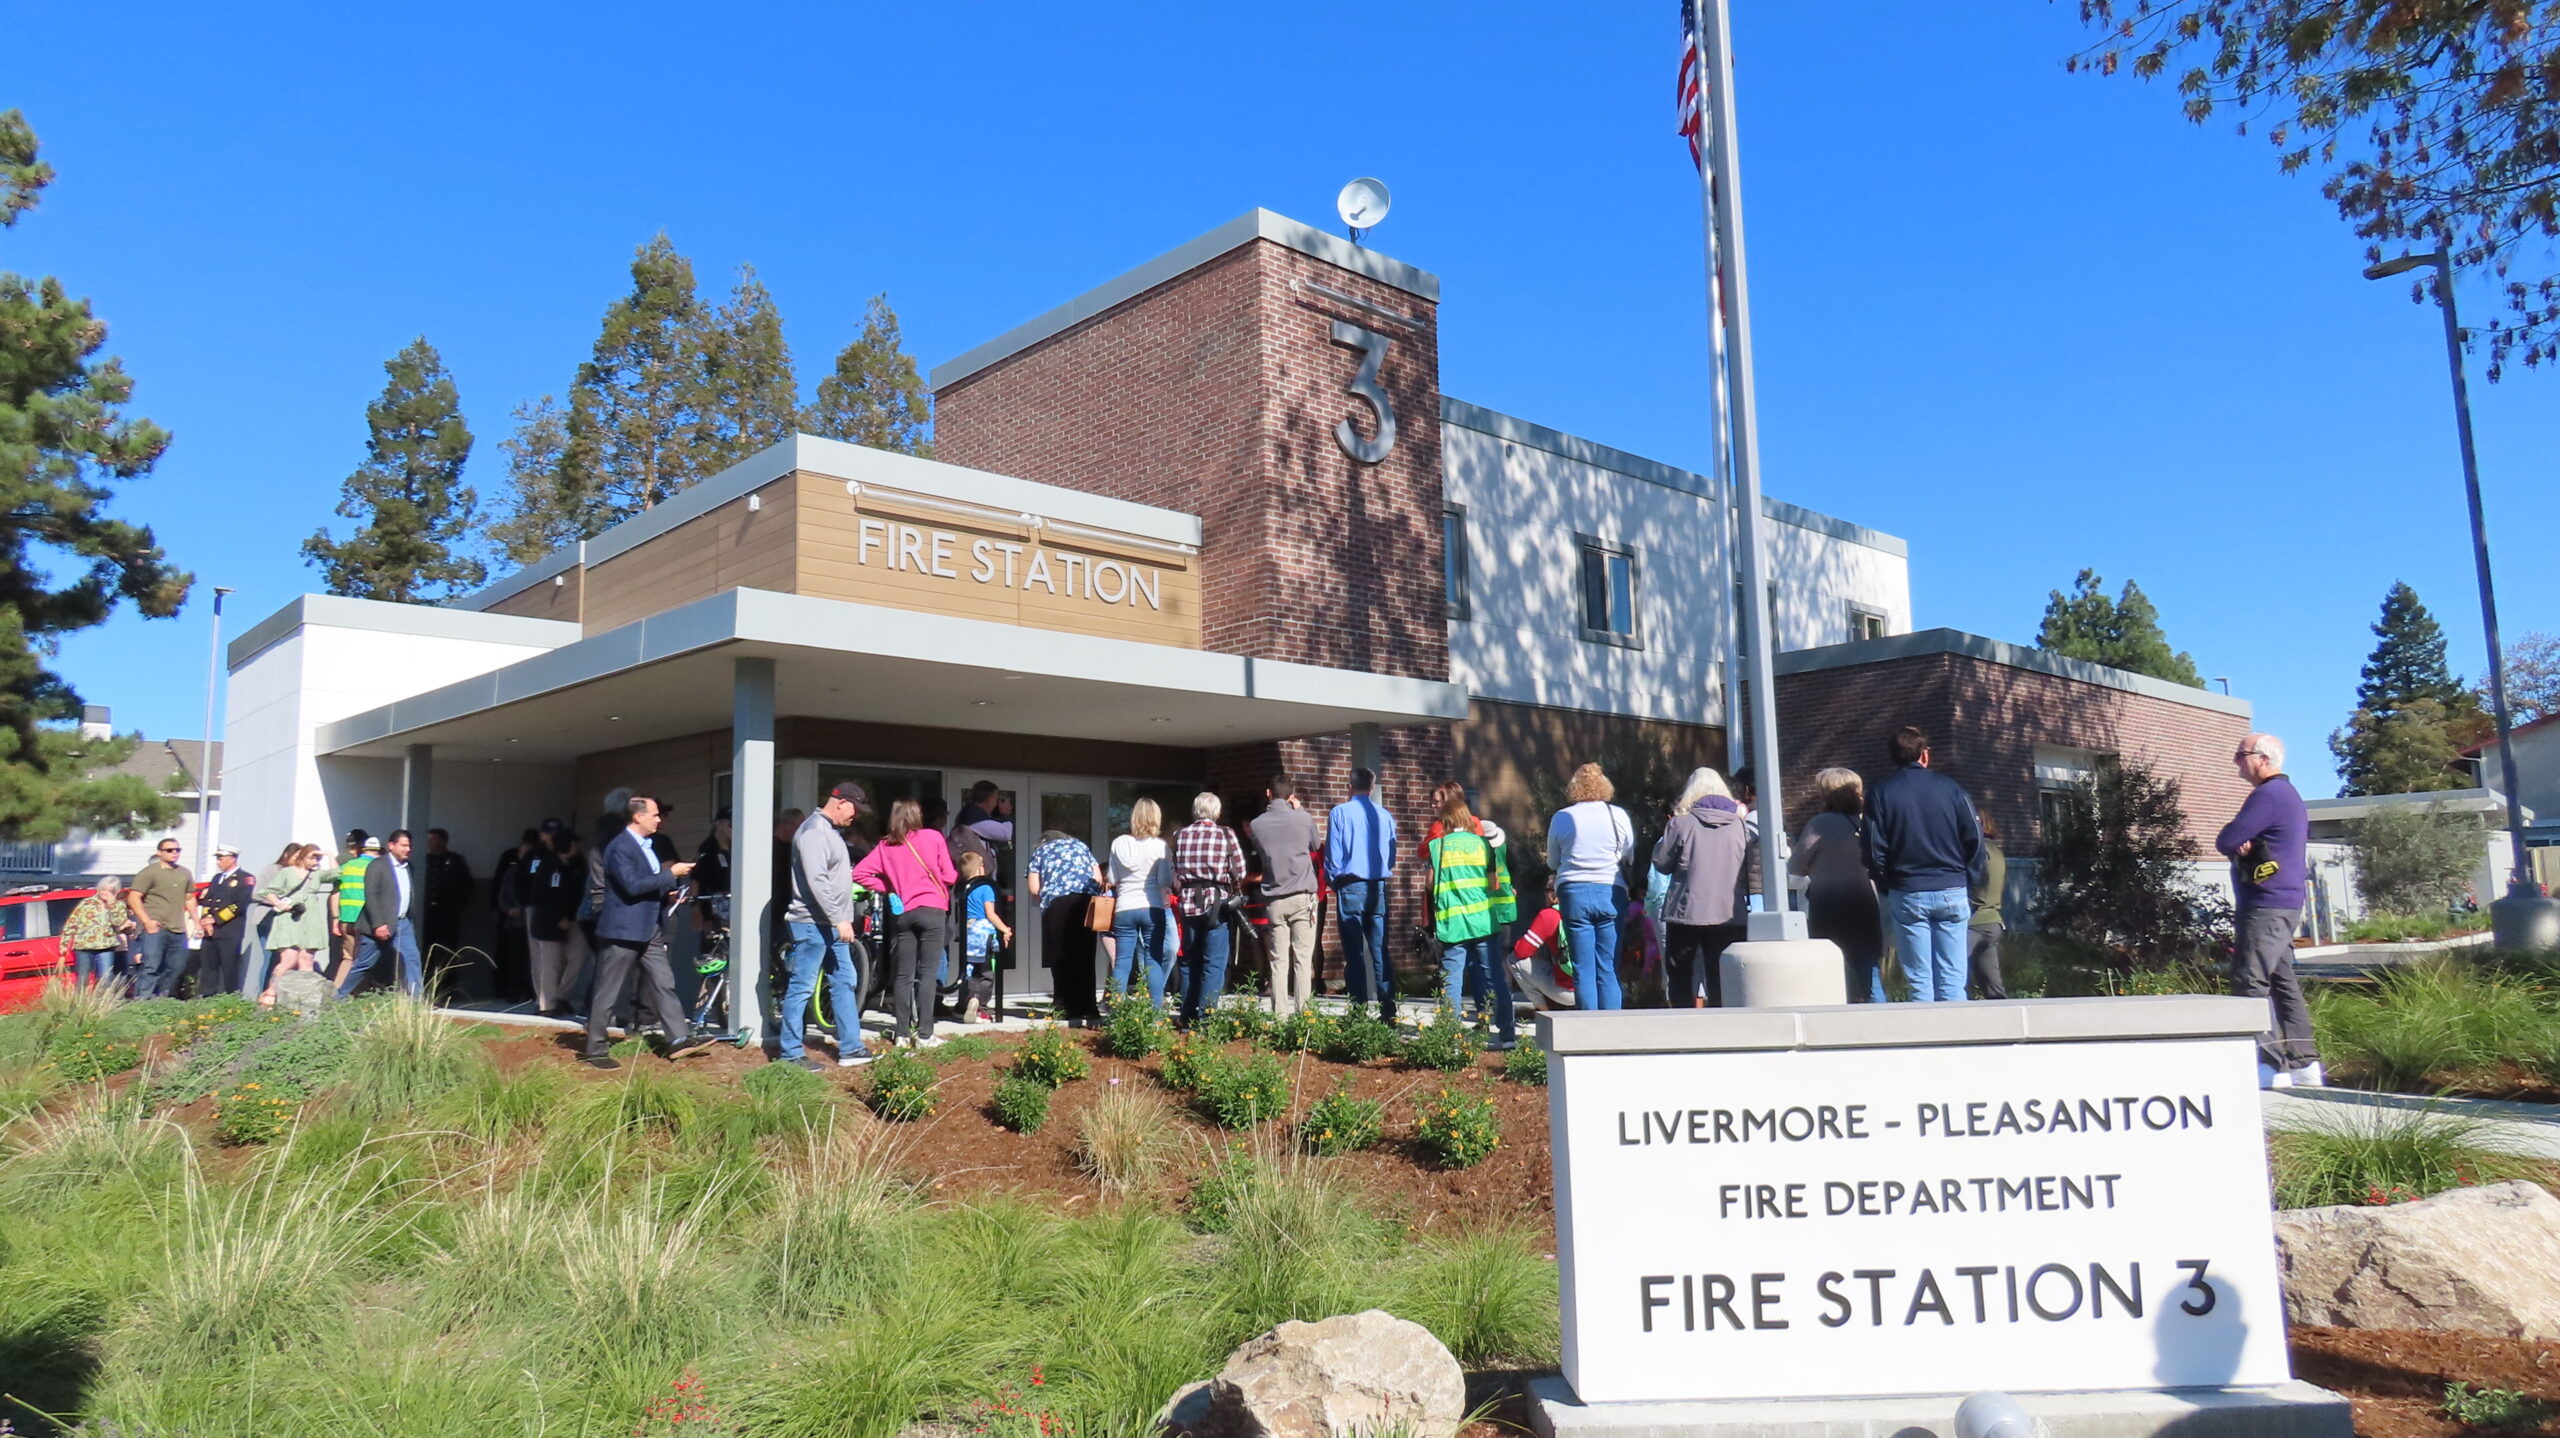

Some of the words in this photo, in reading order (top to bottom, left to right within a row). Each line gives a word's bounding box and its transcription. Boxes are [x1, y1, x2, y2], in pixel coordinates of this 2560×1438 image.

[1331, 320, 1396, 465] 3
[858, 518, 957, 579] FIRE
[971, 538, 1160, 611] STATION
[1619, 1105, 1869, 1146] LIVERMORE
[1918, 1095, 2213, 1137] PLEASANTON
[1720, 1183, 1808, 1219] FIRE
[1824, 1174, 2122, 1216] DEPARTMENT
[1640, 1273, 1789, 1333] FIRE
[1817, 1262, 2144, 1328] STATION
[2177, 1259, 2219, 1318] 3
